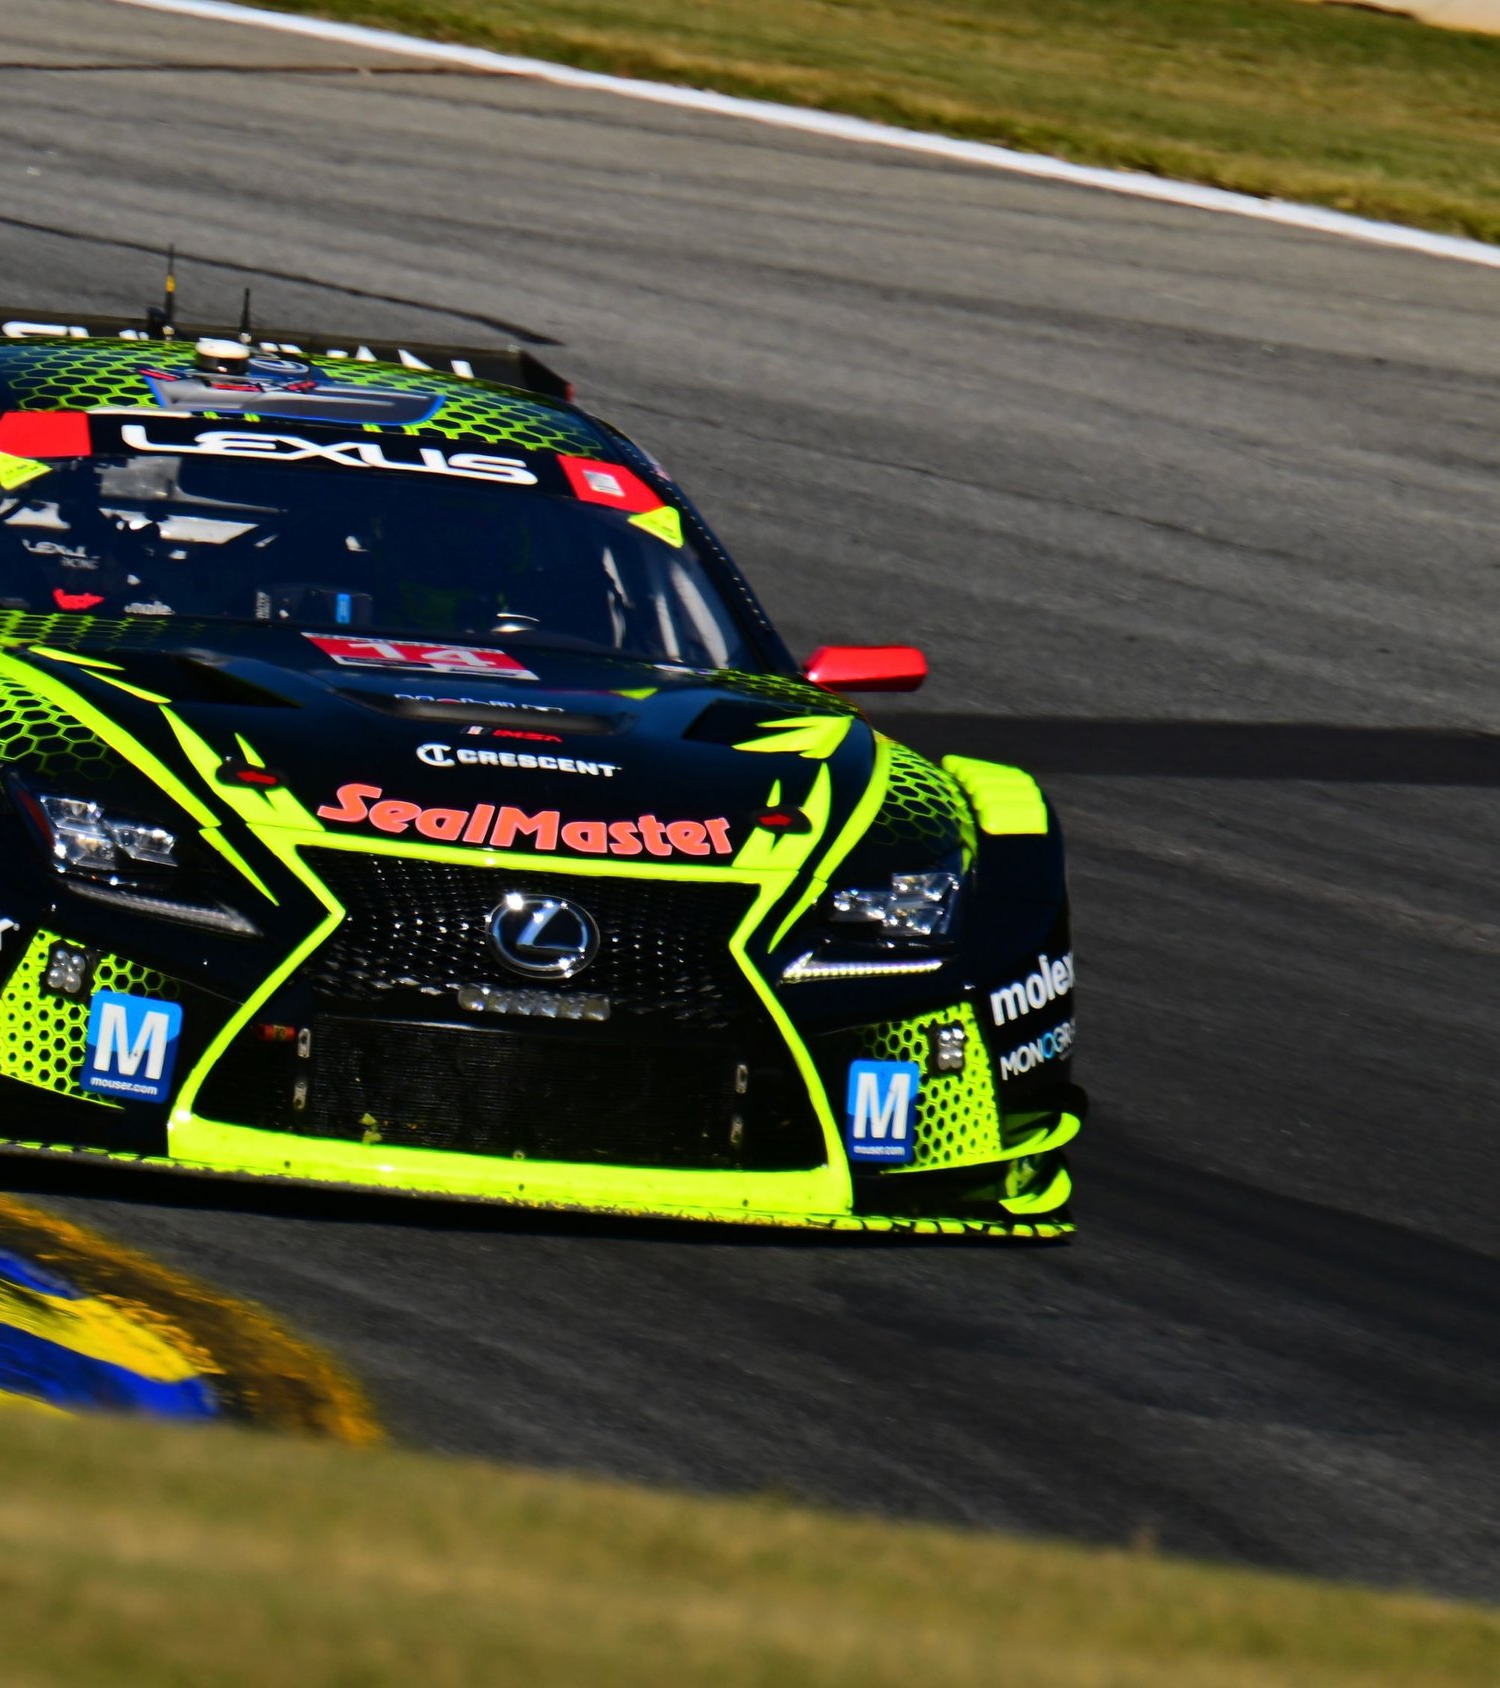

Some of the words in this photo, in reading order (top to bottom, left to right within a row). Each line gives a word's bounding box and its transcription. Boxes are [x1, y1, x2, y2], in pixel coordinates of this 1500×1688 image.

[121, 424, 538, 485] LEXUS
[347, 640, 497, 667] 14
[456, 748, 615, 778] CRESCENT
[317, 783, 735, 856] SealMaster
[93, 1002, 169, 1080] M
[90, 1076, 158, 1096] mouser.com
[853, 1072, 911, 1139] M
